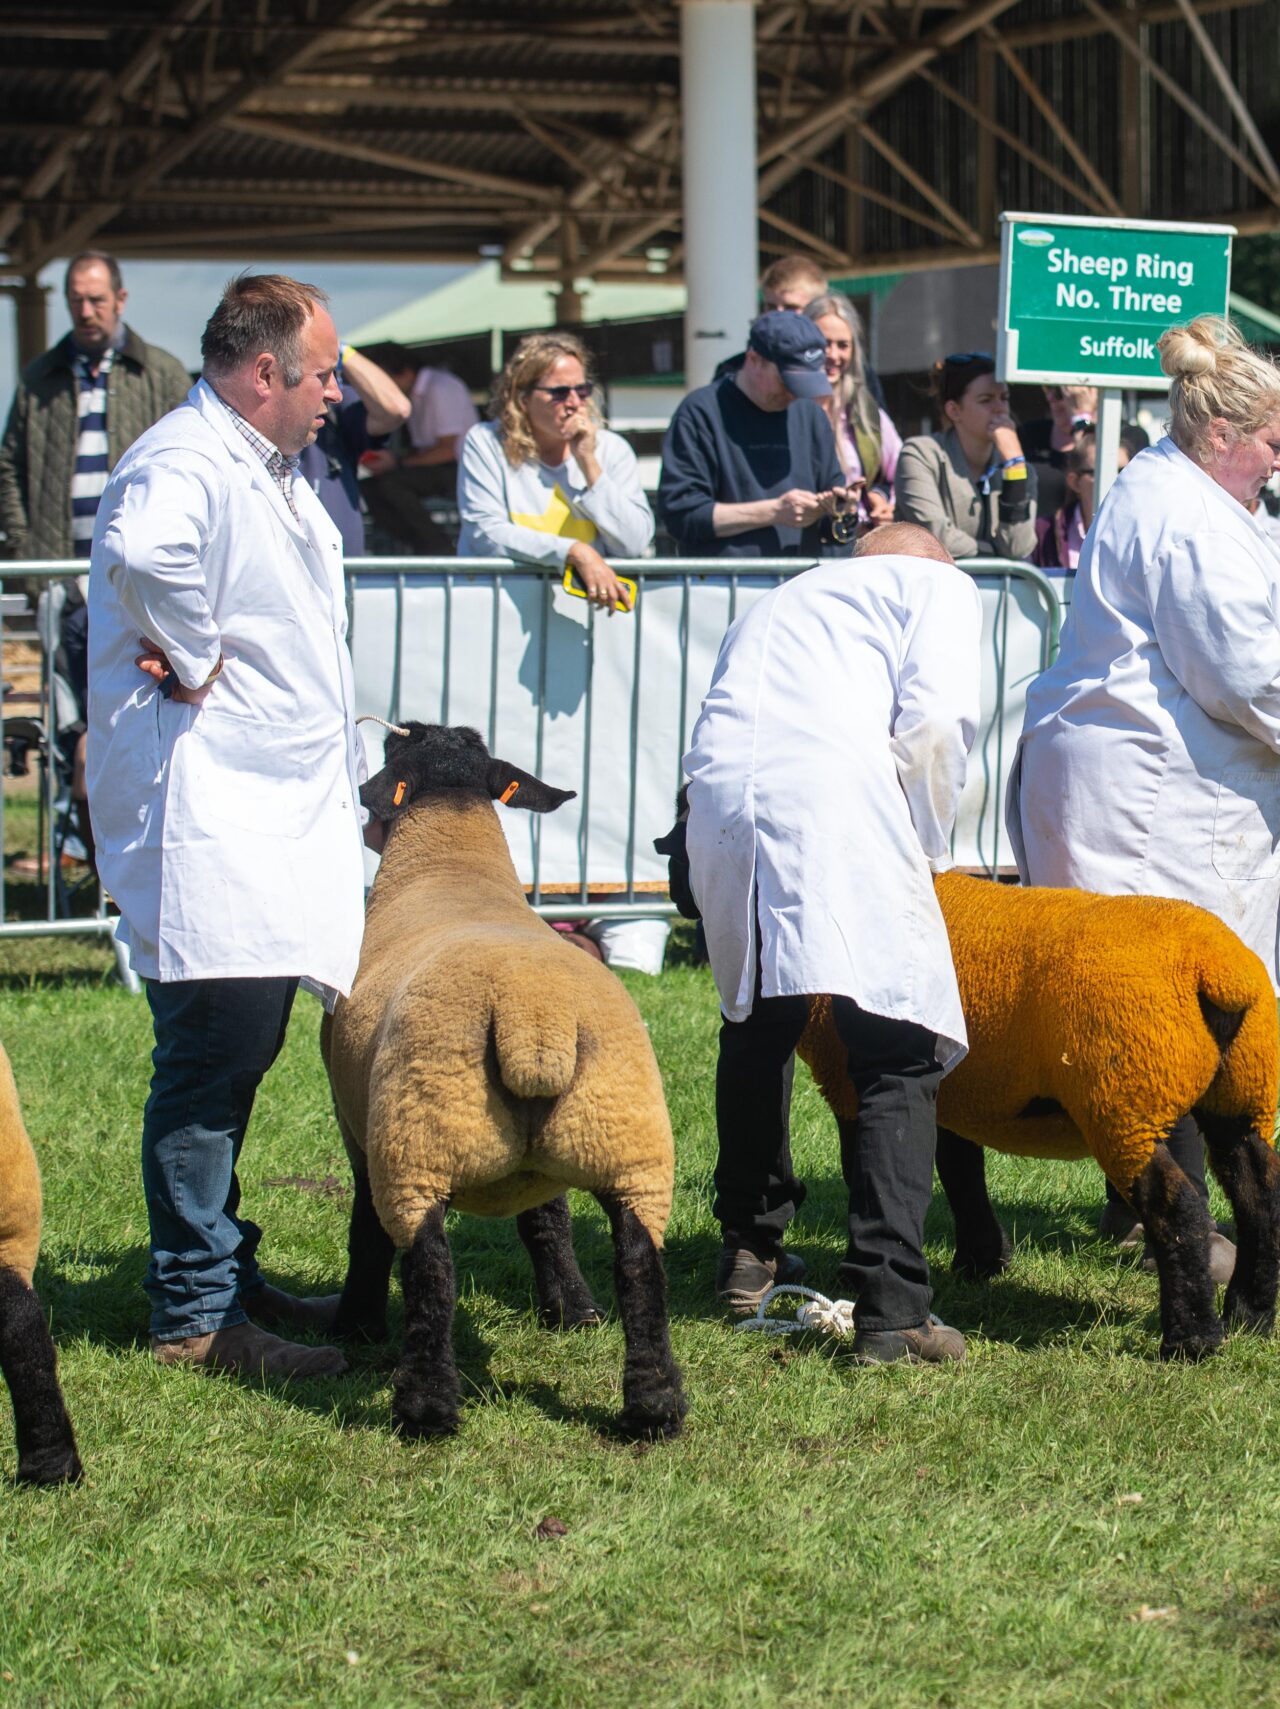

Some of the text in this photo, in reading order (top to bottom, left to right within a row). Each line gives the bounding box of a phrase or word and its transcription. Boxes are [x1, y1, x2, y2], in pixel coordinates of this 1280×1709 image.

[1047, 248, 1194, 286] Sheep Ring
[1056, 283, 1182, 313] No. Three
[1079, 335, 1155, 360] Suffolk
